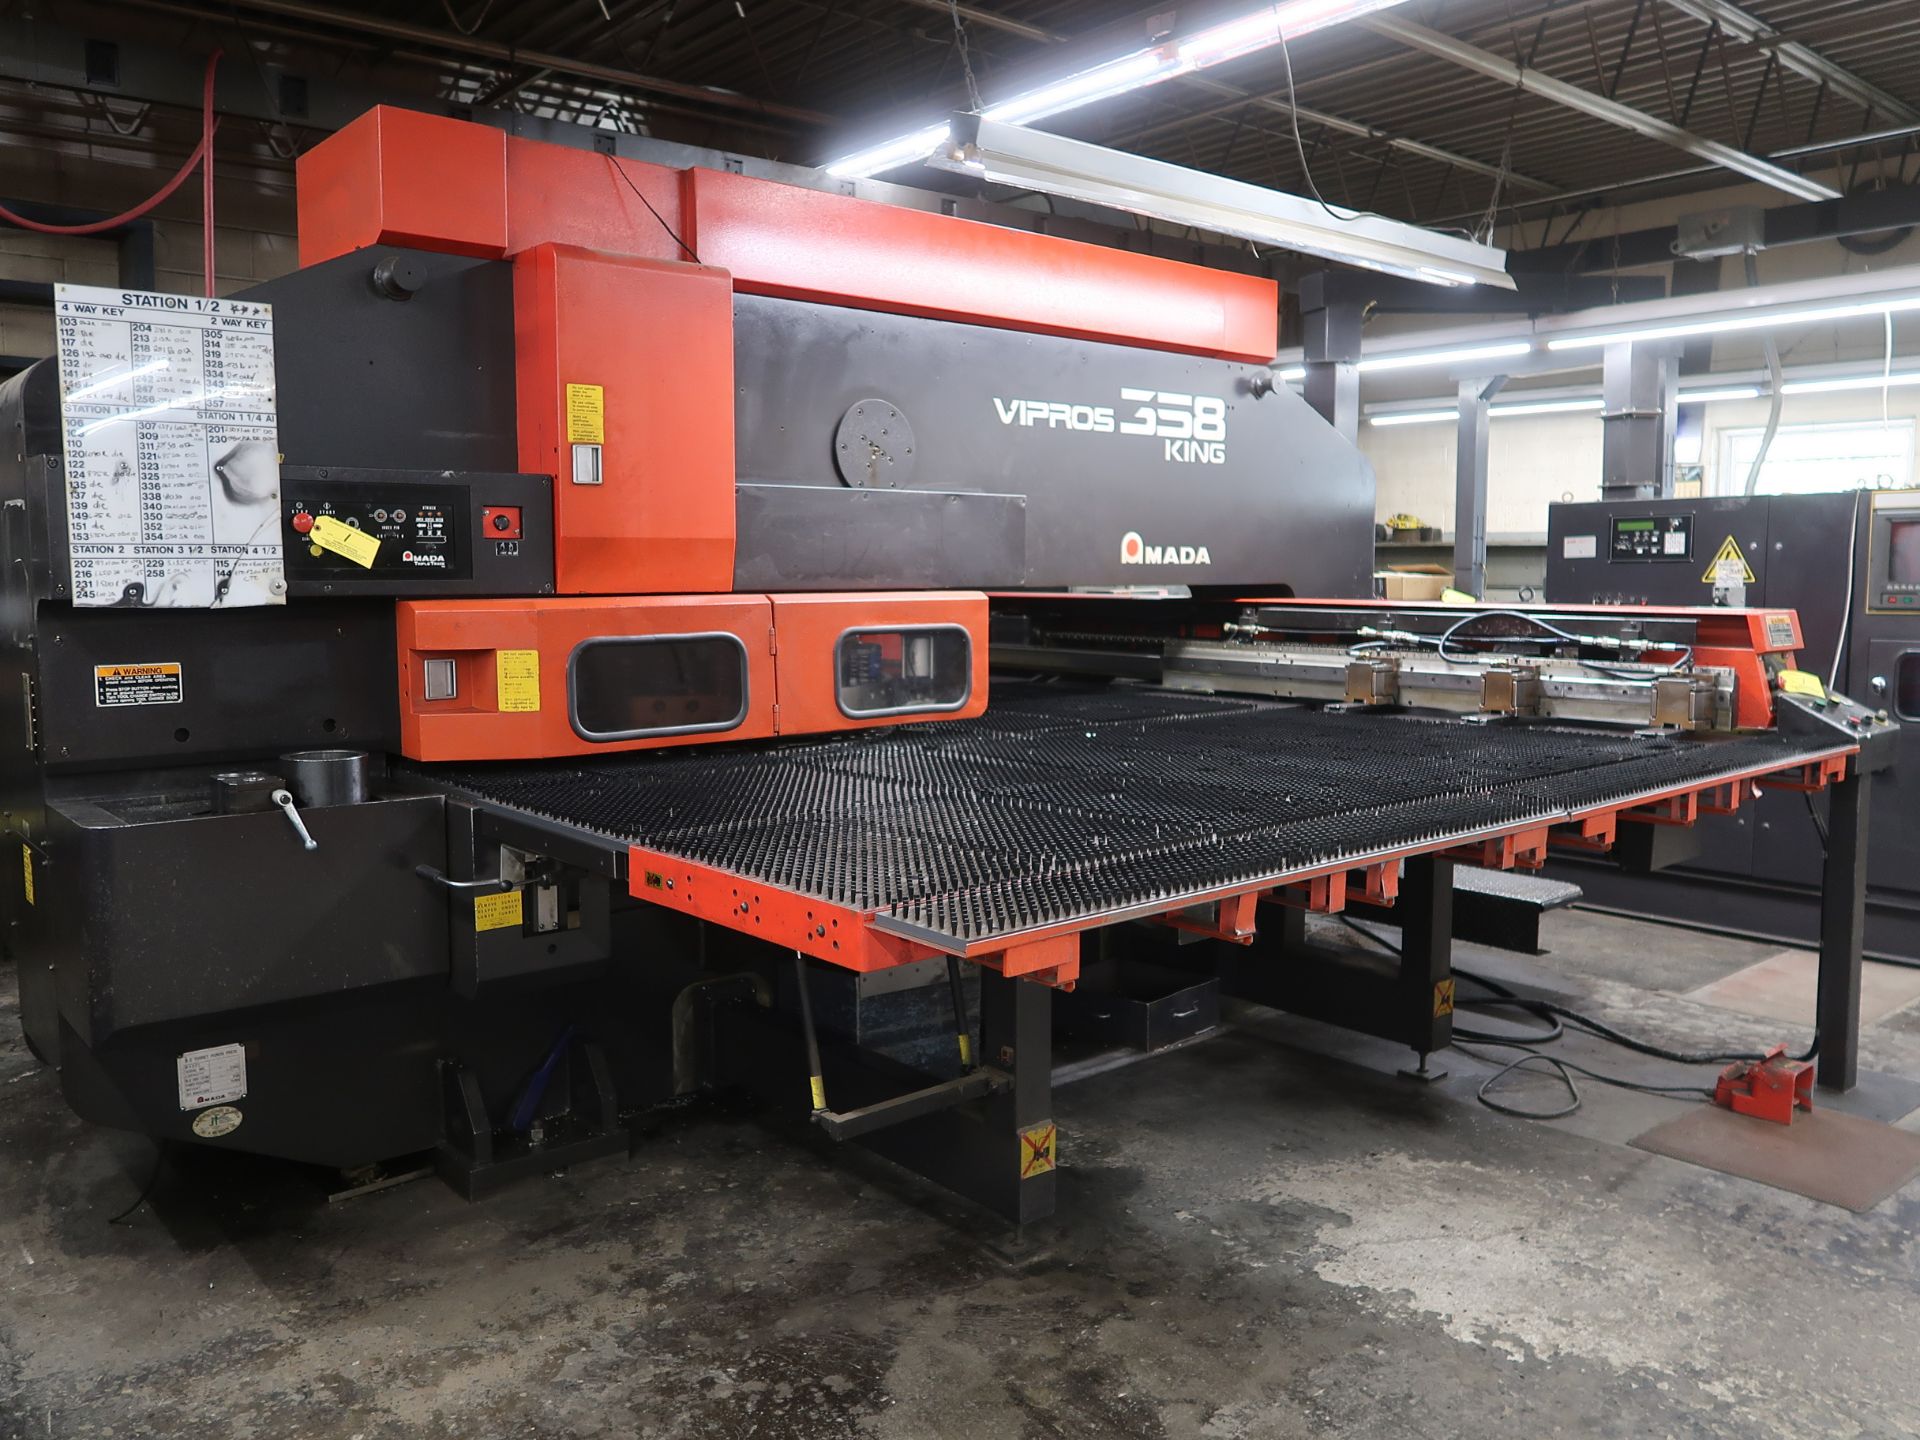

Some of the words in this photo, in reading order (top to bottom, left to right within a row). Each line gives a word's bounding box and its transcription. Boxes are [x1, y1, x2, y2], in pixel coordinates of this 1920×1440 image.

[122, 293, 188, 309] STATION
[195, 300, 220, 312] 1/2
[74, 305, 97, 313] WAY
[102, 307, 124, 316] KEY
[59, 318, 77, 326] 103
[211, 317, 217, 325] 2
[221, 318, 242, 327] WAY
[246, 321, 267, 329] KEY
[132, 323, 152, 332] 204
[133, 334, 150, 342] 213
[204, 330, 222, 339] 305
[61, 338, 75, 346] 117
[204, 340, 221, 348] 314
[134, 344, 150, 352] 218
[62, 349, 79, 357] 126
[205, 350, 221, 358] 319
[62, 359, 80, 368] 132
[205, 360, 223, 368] 328
[206, 370, 224, 378] 334
[206, 380, 224, 388] 343
[207, 400, 224, 408] 357
[64, 404, 110, 414] STATION
[197, 412, 235, 420] STATION
[247, 414, 261, 422] 1/4
[993, 397, 1115, 432] VIPROS
[1119, 387, 1226, 442] 358
[66, 419, 84, 427] 106
[138, 422, 156, 430] 307
[139, 432, 158, 440] 309
[67, 440, 82, 448] 110
[140, 442, 154, 450] 311
[67, 450, 85, 458] 120
[1164, 439, 1226, 464] KING
[140, 452, 157, 460] 321
[68, 460, 85, 468] 122
[141, 462, 159, 470] 323
[69, 481, 86, 489] 135
[142, 482, 161, 490] 336
[70, 502, 88, 510] 139
[71, 512, 88, 520] 149
[72, 546, 114, 554] STATION
[134, 546, 174, 554] STATION
[178, 546, 184, 554] 3
[189, 546, 203, 554] 1/2
[211, 546, 248, 554] STATION
[1120, 531, 1211, 565] AMADA
[403, 551, 445, 562] AMADA
[74, 560, 94, 568] 202
[146, 560, 164, 568] 229
[216, 560, 230, 568] 115
[75, 570, 92, 578] 216
[146, 570, 164, 578] 258
[197, 1095, 226, 1103] AMADA
